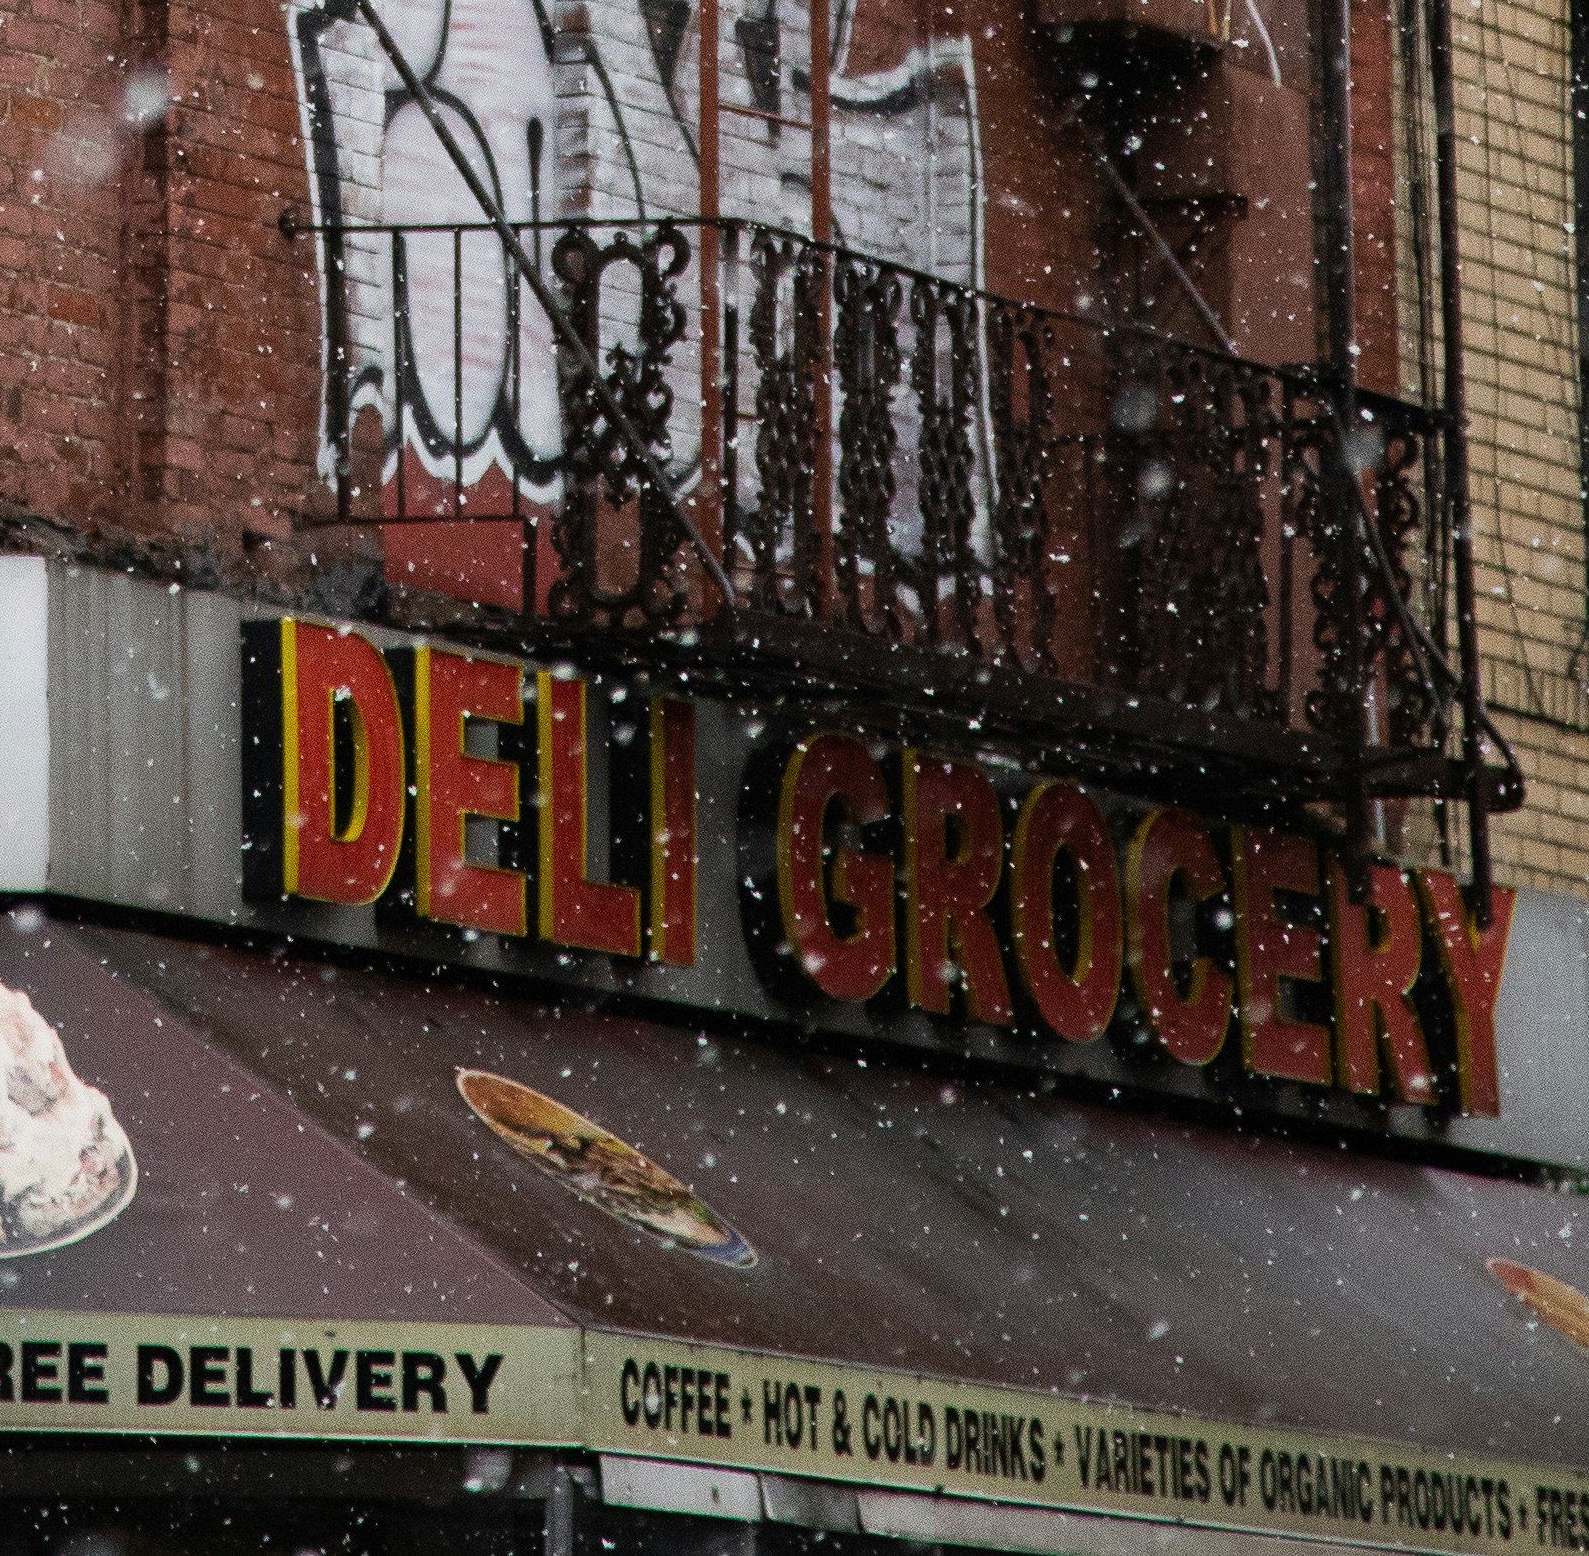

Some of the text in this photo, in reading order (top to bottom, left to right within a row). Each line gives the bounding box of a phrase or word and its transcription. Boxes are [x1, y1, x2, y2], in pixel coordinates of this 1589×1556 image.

[280, 615, 1518, 1118] DELI GROCERY
[135, 1342, 505, 1415] DELIVERY
[620, 1357, 733, 1439] COFFEE
[762, 1377, 822, 1451] HOT
[831, 1388, 853, 1457] &
[861, 1392, 936, 1466] COLD
[944, 1404, 1046, 1484] DRINKS
[1073, 1423, 1211, 1504] VARIETIES
[1217, 1441, 1251, 1507] OF
[1258, 1446, 1375, 1523] ORGANIC
[1377, 1462, 1512, 1541] PRODUCTS
